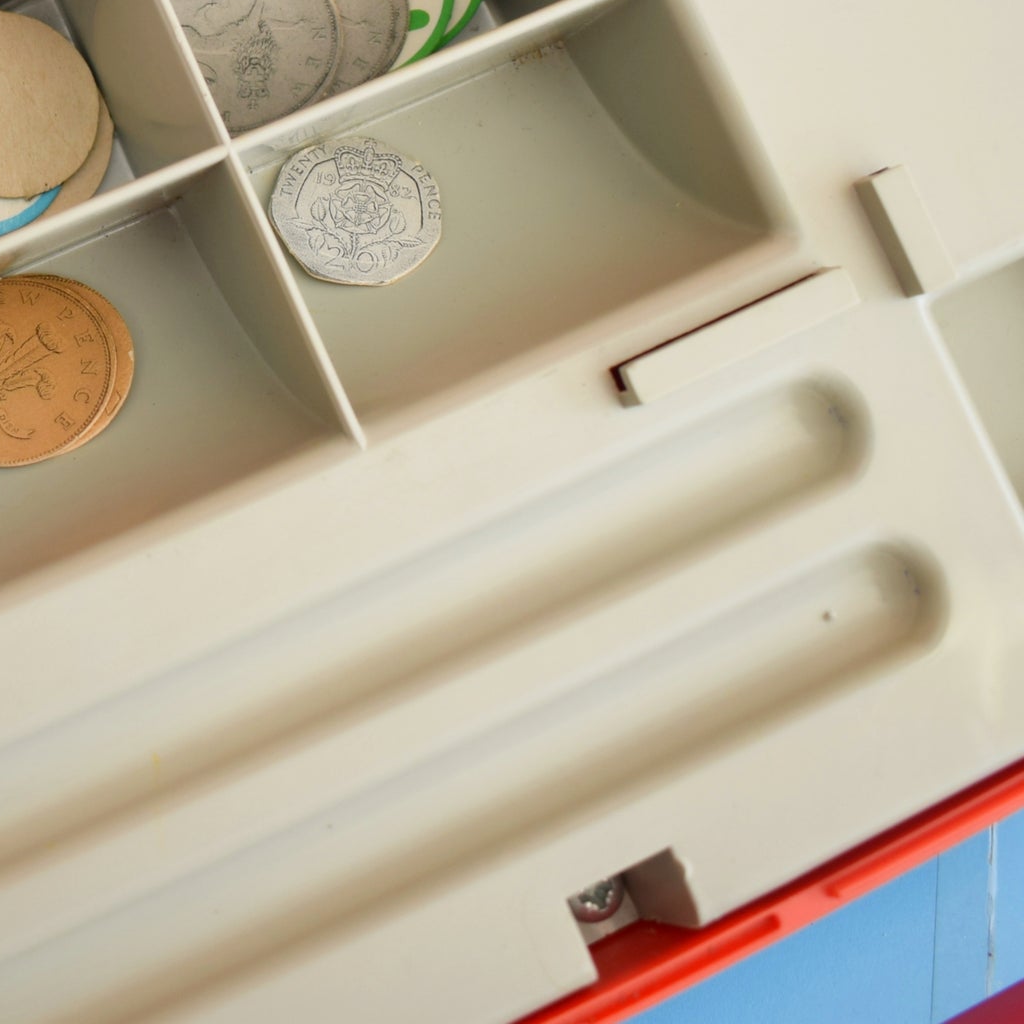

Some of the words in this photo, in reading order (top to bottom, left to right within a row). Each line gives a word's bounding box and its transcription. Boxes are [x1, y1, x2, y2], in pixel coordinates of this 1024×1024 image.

[279, 144, 327, 197] TWENTY
[410, 164, 442, 221] PENCE
[54, 307, 97, 431] PENCE
